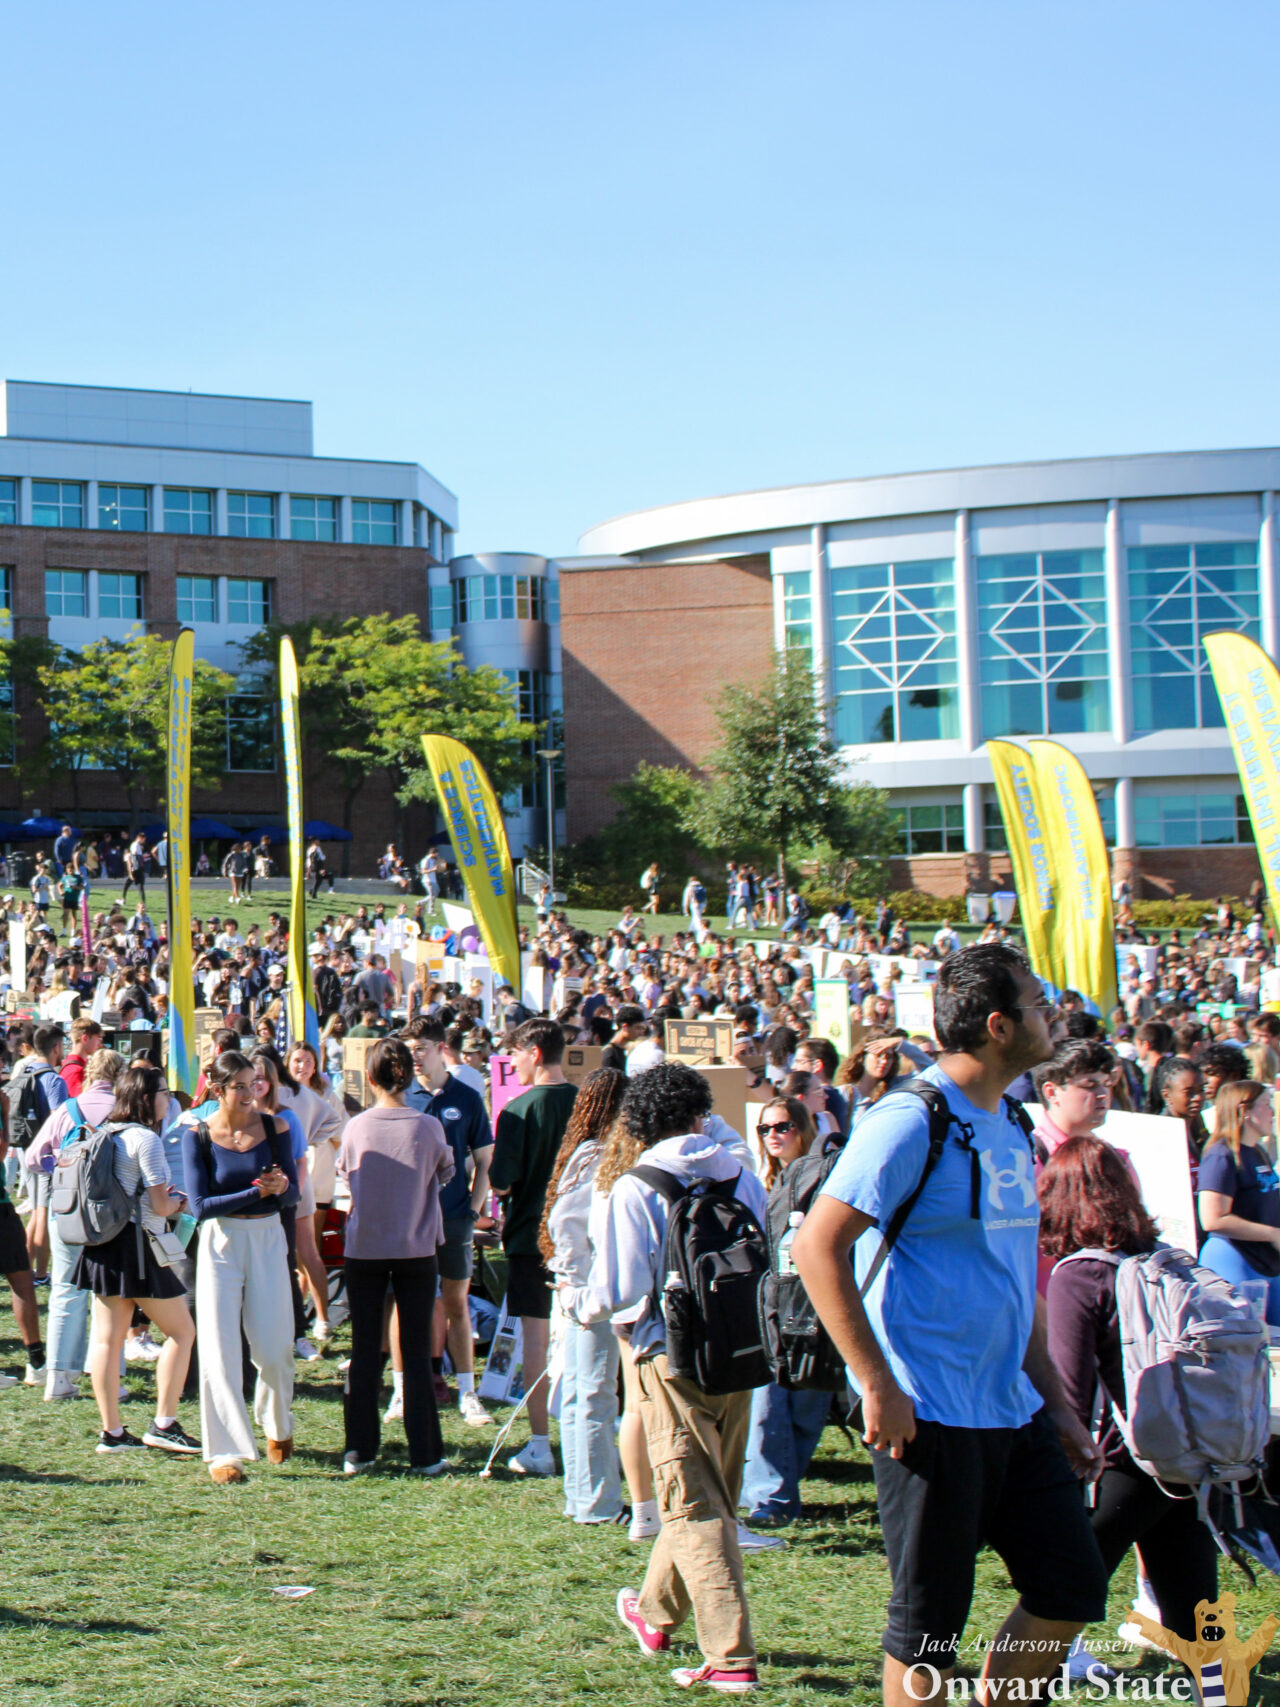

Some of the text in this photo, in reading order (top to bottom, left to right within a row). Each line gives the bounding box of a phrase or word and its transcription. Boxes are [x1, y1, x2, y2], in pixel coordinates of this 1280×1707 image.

[439, 770, 477, 868] SCIENCE &
[459, 760, 506, 897] MATHEMATICS
[1223, 691, 1276, 832] INTEREST
[1011, 764, 1055, 911] HONOR SOCIETY
[1054, 764, 1096, 920] PHILANTHROPIC
